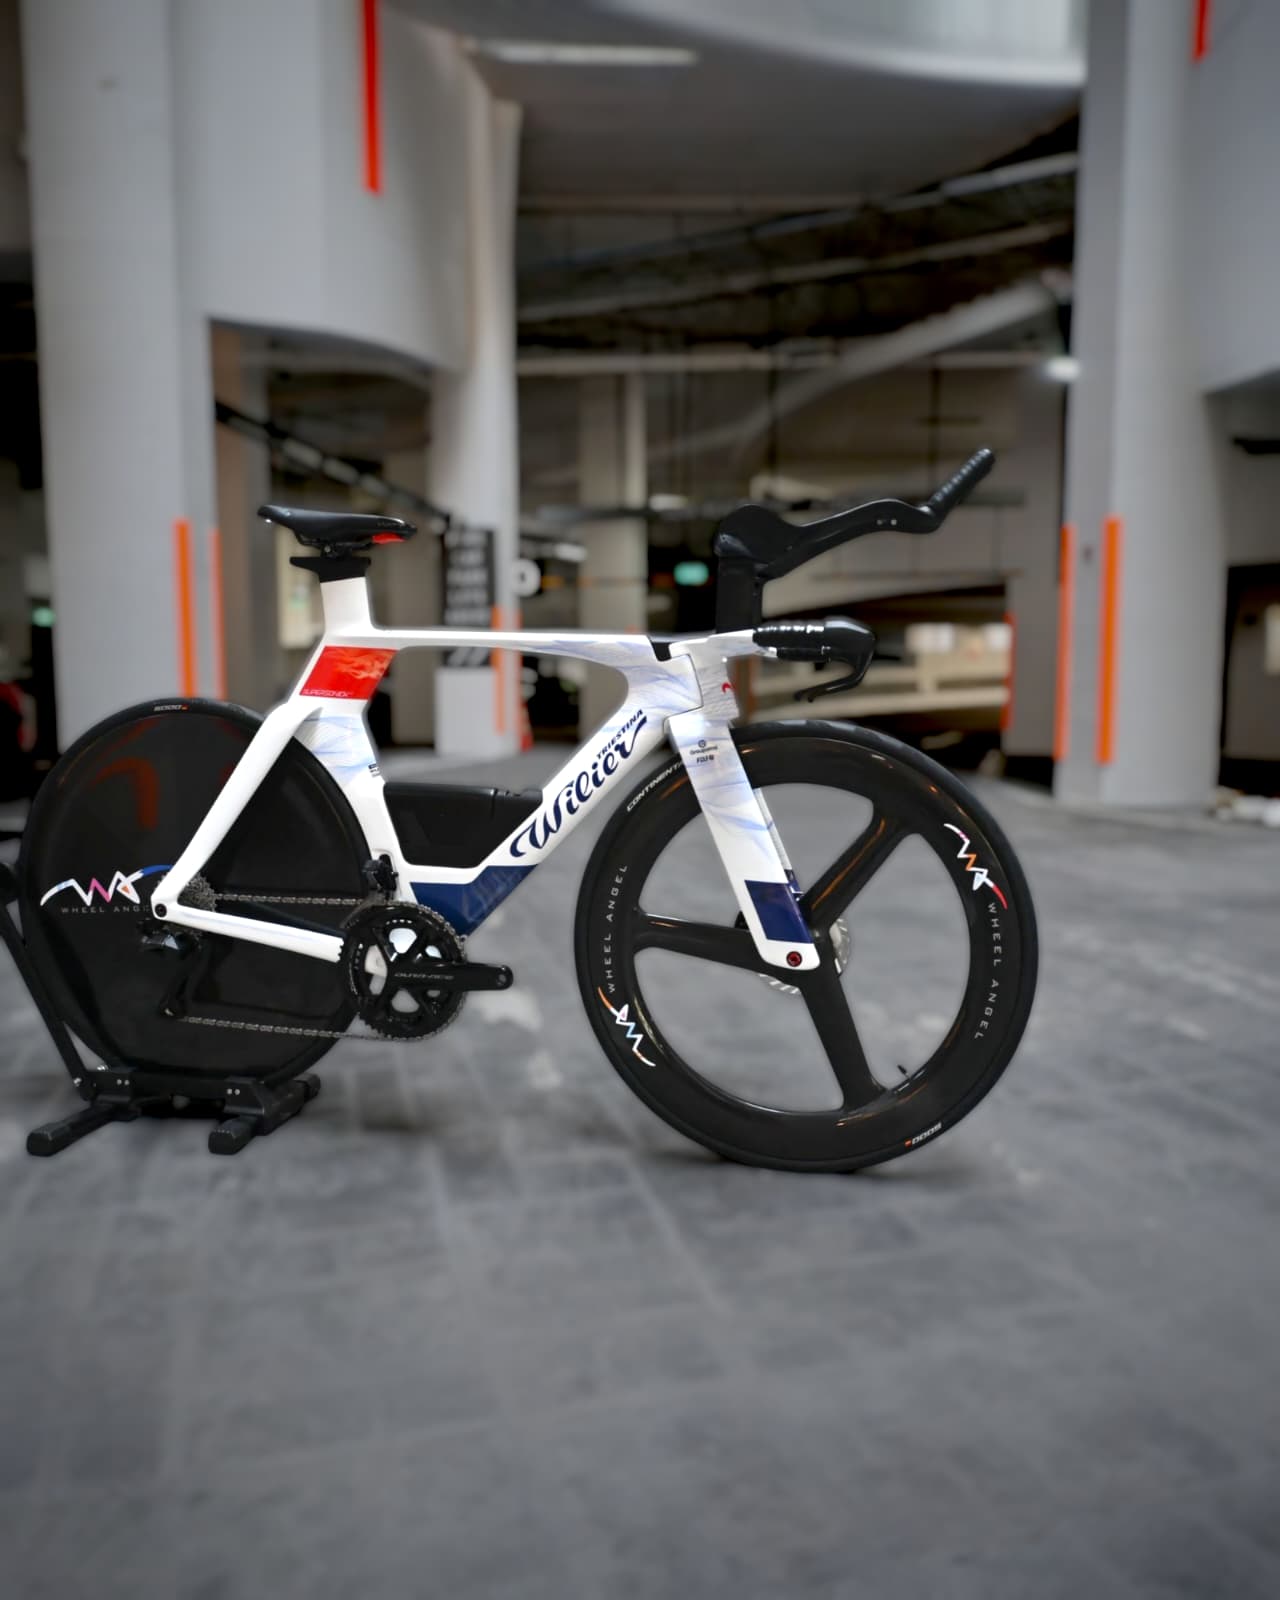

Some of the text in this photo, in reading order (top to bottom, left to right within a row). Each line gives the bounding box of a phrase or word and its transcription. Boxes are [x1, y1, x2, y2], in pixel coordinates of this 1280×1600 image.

[596, 708, 643, 760] TRIESTINA
[509, 715, 647, 858] Wilier
[626, 760, 684, 813] CONTINENTA
[61, 906, 105, 914] WHEEL
[604, 865, 628, 994] WHEEL ANGEL
[974, 902, 1002, 1039] WHEEL ANGEL
